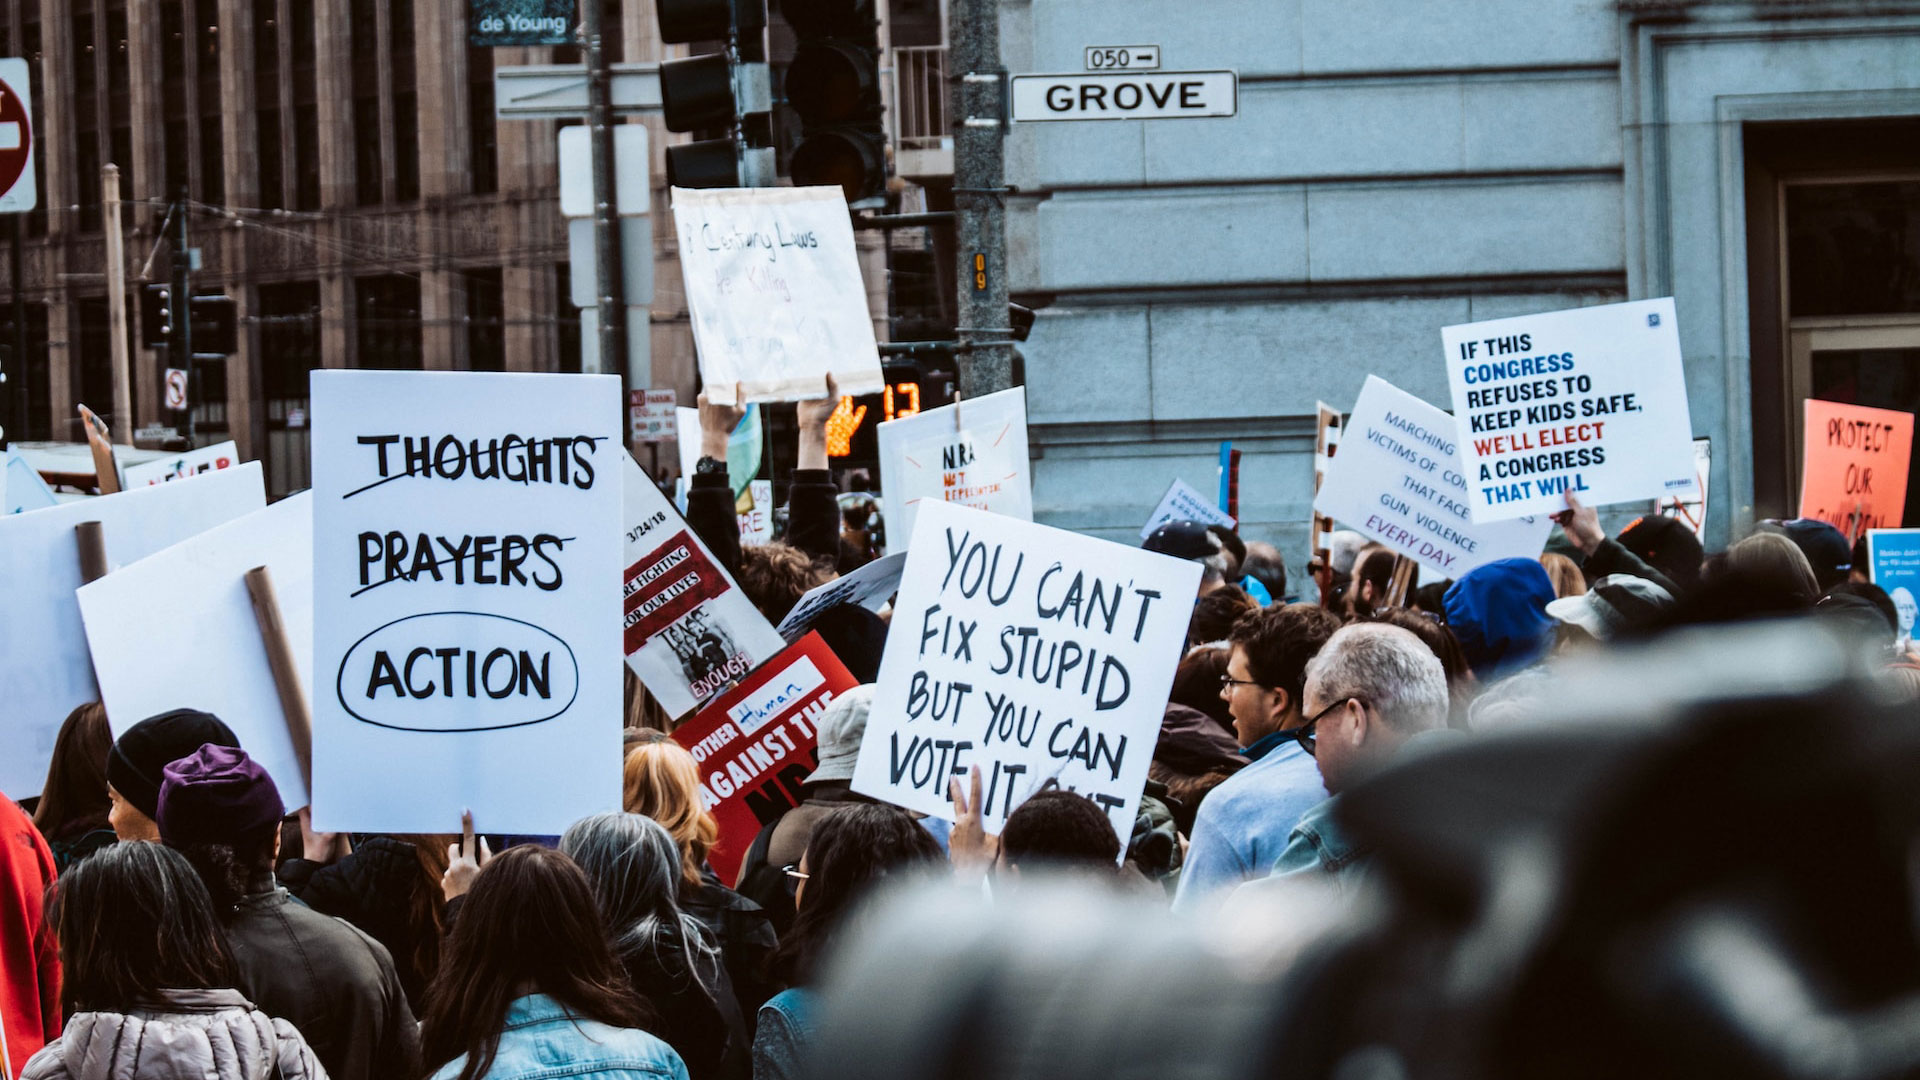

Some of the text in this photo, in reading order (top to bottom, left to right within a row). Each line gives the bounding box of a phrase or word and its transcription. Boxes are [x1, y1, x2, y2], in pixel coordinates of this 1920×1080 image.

[480, 13, 566, 34] de Young
[1092, 49, 1130, 67] 050
[1046, 82, 1206, 111] GROVE
[775, 221, 818, 249] Laws
[1460, 333, 1532, 361] IF THIS
[1464, 352, 1574, 384] CONGRESS
[1467, 375, 1591, 409] REFUSES TO
[1471, 393, 1642, 433] KEEP KIDS SAFE,
[1367, 428, 1416, 462] VICTIMS
[1419, 456, 1438, 473] OF
[1385, 411, 1456, 456] MARCHING
[1474, 422, 1605, 457] WE'LL ELECT
[1828, 417, 1893, 453] PROTECT
[357, 434, 596, 490] THOUGHTS
[943, 441, 976, 470] NRA
[1480, 447, 1606, 481] A CONGRESS
[1403, 475, 1471, 519] THAT FACE
[1482, 474, 1589, 505] THAT WILL
[1845, 463, 1873, 494] OUR
[626, 511, 666, 543] 3/24/18
[1366, 514, 1420, 549] EVERY
[1380, 493, 1477, 552] GUN VIOLENCE
[359, 531, 563, 590] PRAYERS
[624, 547, 689, 598] RE FIGHTING
[643, 593, 668, 613] OUR
[667, 572, 699, 597] LIVES
[939, 526, 1161, 643] YOU CAN'T
[366, 647, 550, 699] ACTION
[919, 603, 978, 663] FIX
[989, 626, 1131, 711] STUPID
[738, 684, 802, 728] Human
[906, 670, 1128, 783] BUT YOU CAN
[699, 725, 797, 812] AGAINST
[891, 730, 973, 803] VOTE
[984, 760, 1027, 821] IT
